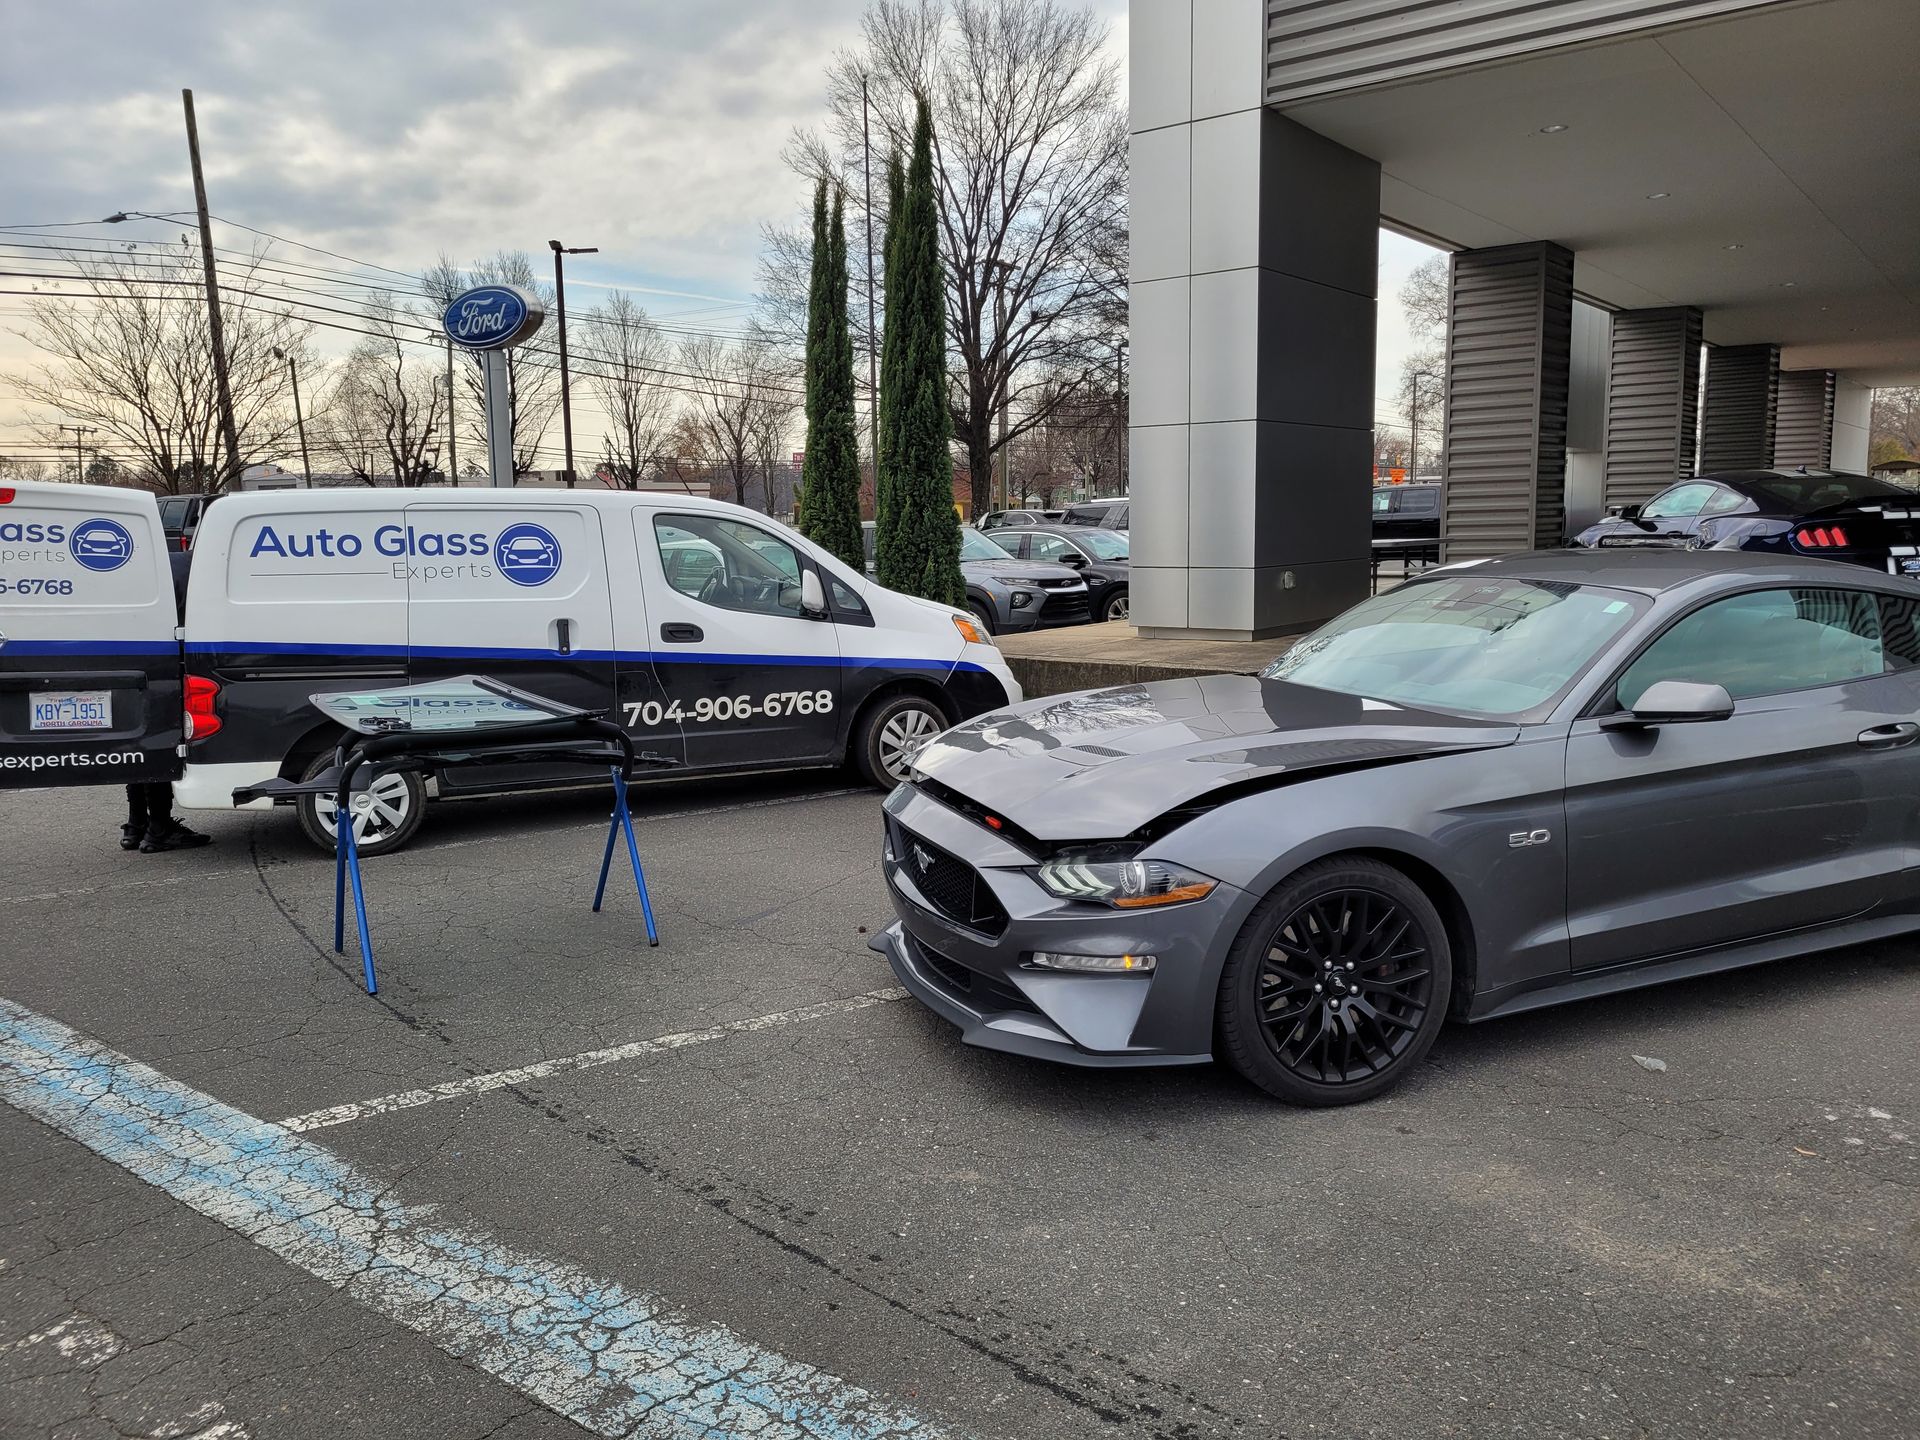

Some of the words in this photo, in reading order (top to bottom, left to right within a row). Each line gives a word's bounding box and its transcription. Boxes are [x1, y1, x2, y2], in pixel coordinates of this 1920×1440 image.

[458, 298, 506, 336] Ford
[249, 525, 362, 557] Auto
[373, 525, 490, 557] Glass
[393, 562, 492, 583] Experts
[36, 703, 105, 720] KBY-1951
[623, 690, 833, 727] 704-906-6768
[1509, 829, 1551, 848] 5.0
